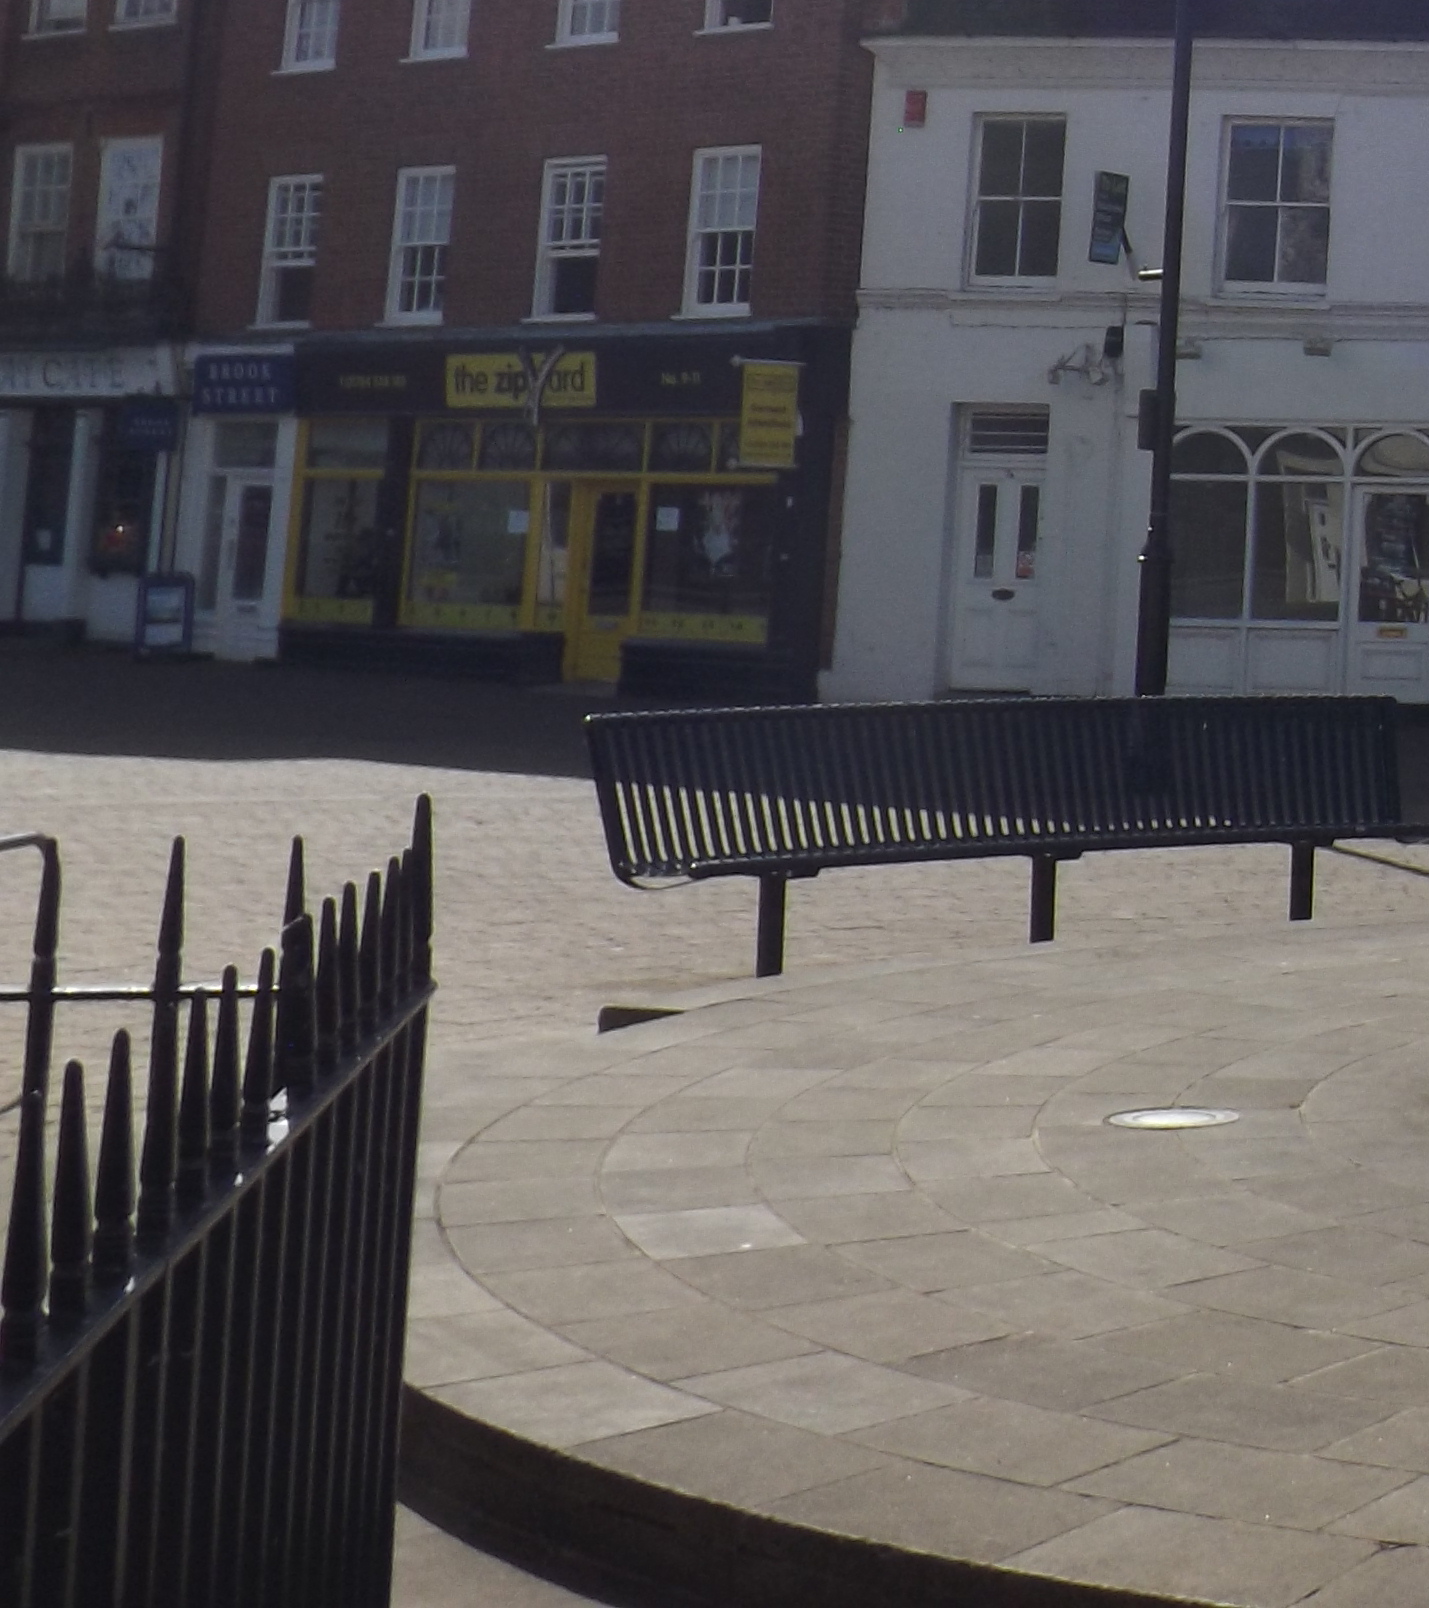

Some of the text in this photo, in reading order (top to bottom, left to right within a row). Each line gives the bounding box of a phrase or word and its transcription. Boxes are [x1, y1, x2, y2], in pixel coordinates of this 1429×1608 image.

[208, 363, 272, 380] BROOK
[453, 363, 488, 394] the
[200, 387, 280, 405] STREET
